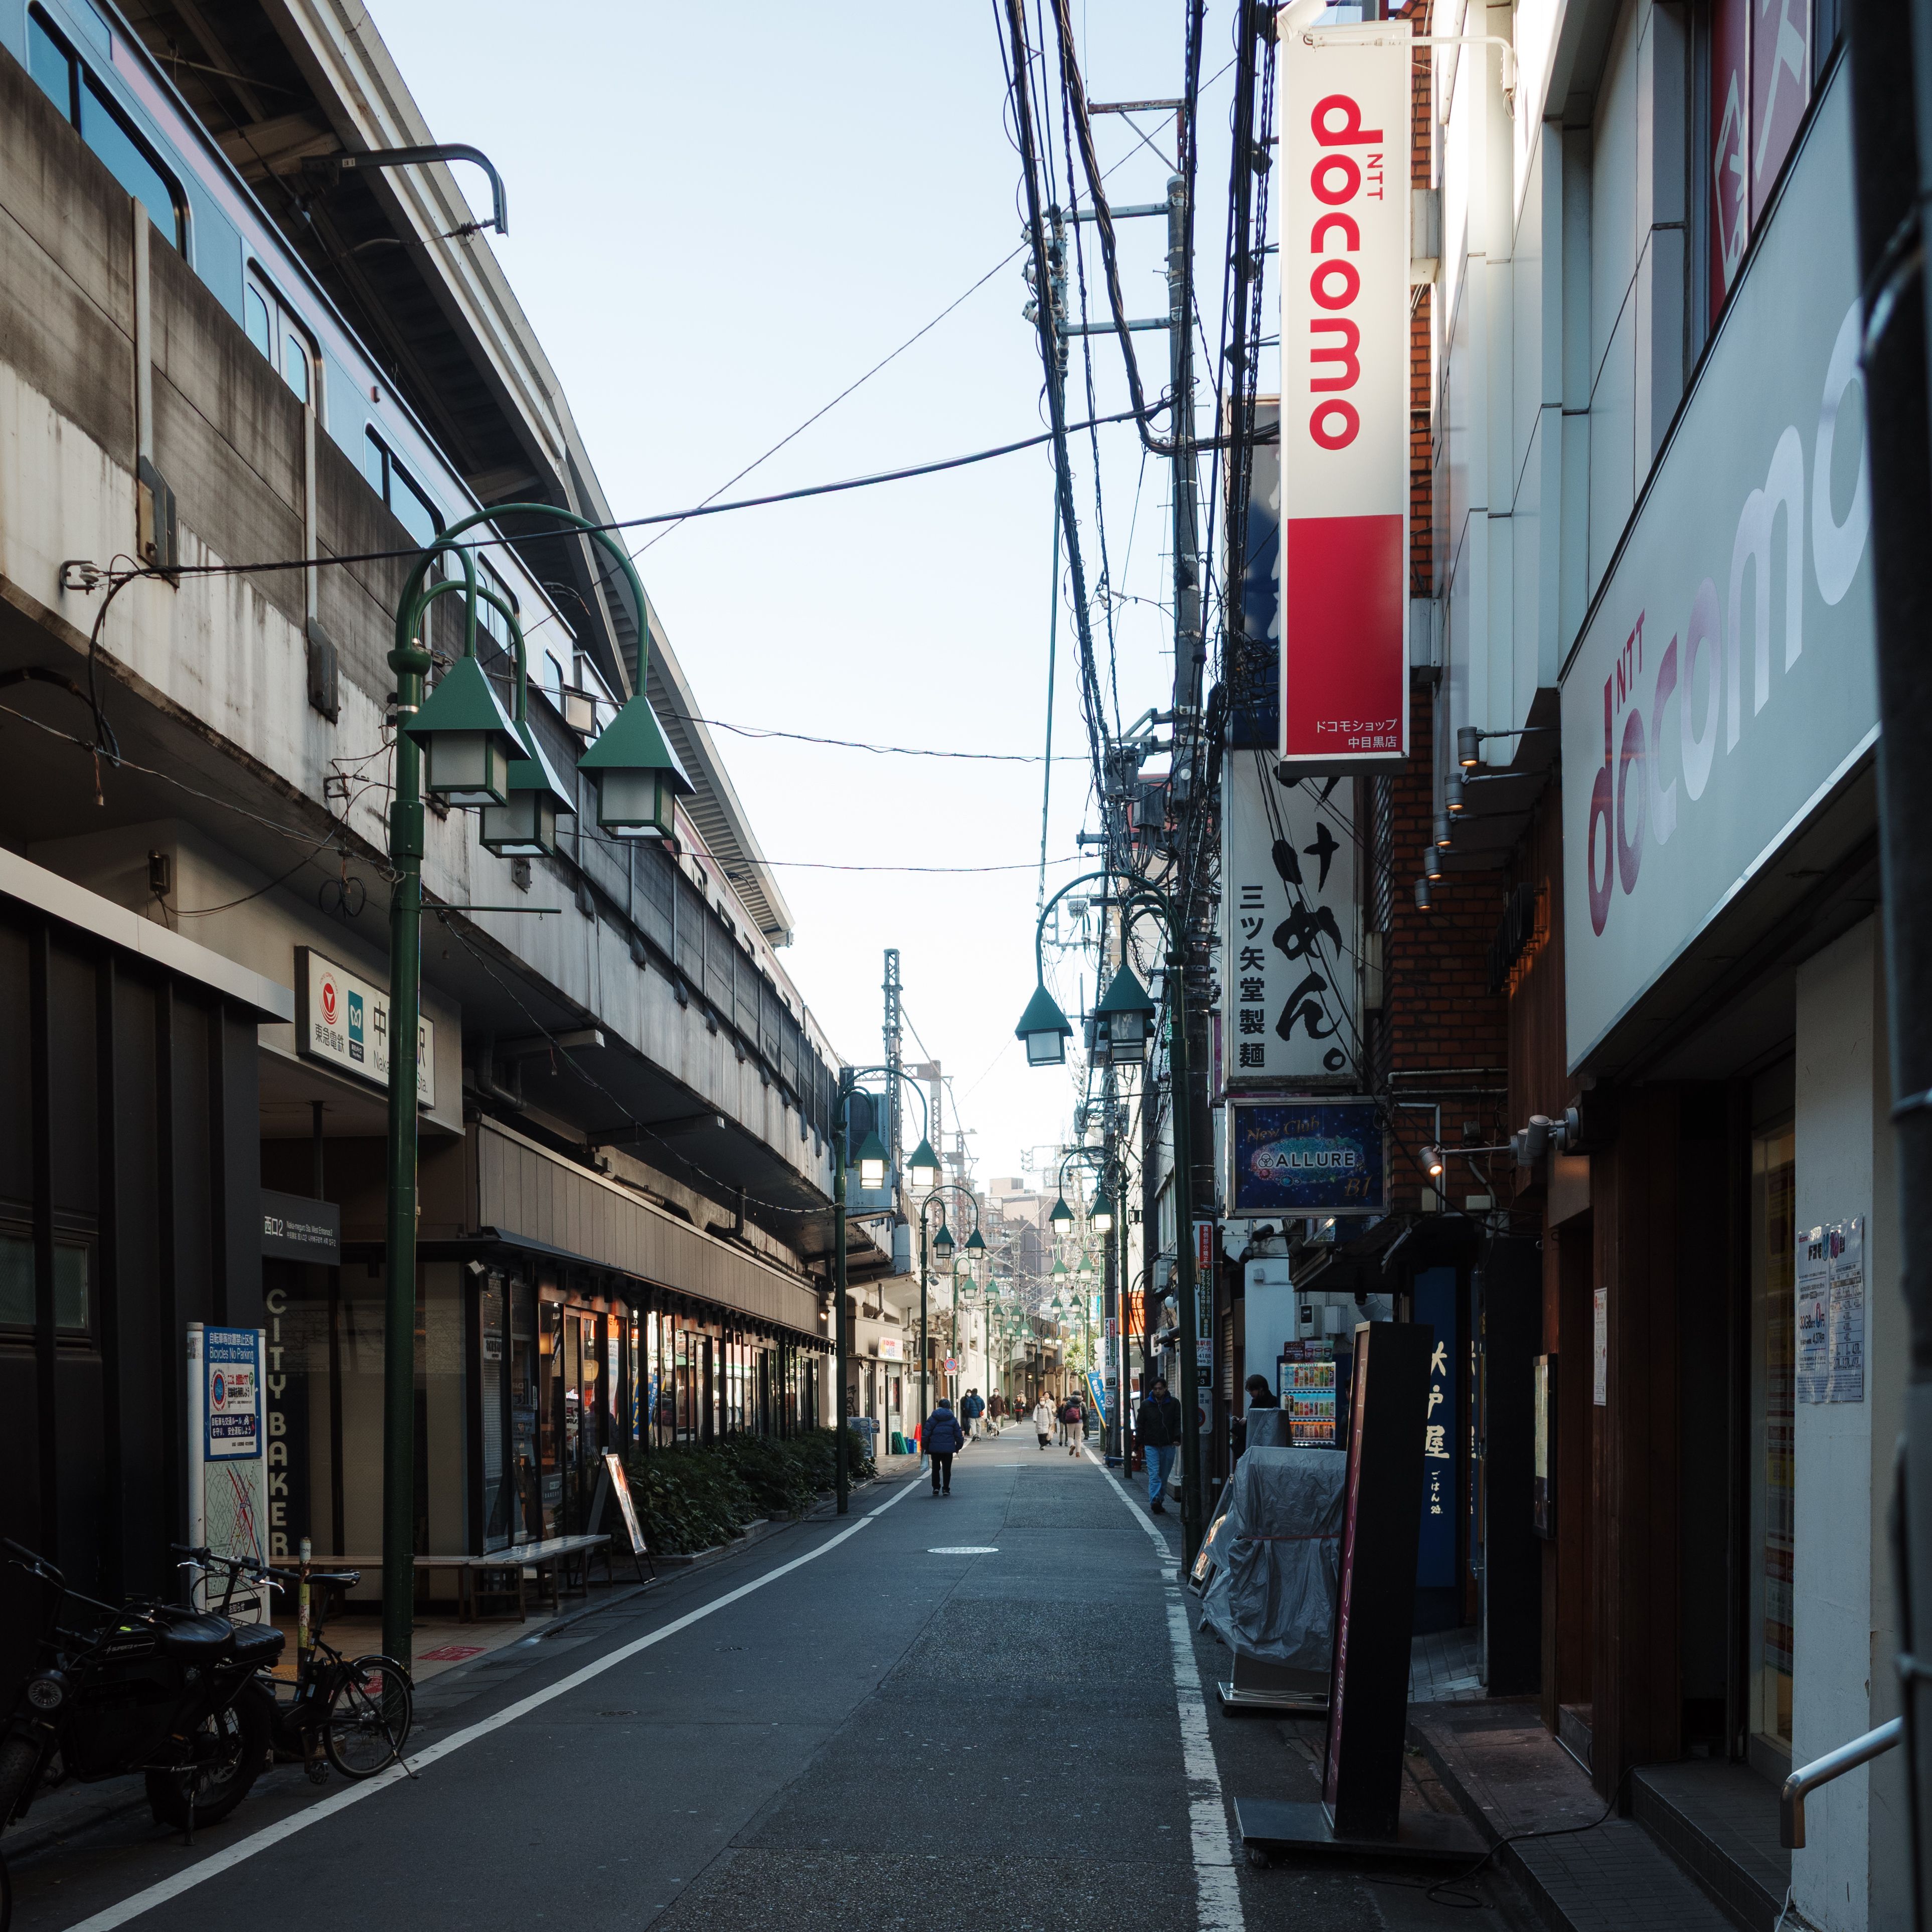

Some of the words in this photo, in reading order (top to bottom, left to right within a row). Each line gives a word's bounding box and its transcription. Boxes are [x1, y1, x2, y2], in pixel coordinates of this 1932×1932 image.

[1367, 153, 1383, 200] NTT
[1310, 94, 1383, 449] docomo
[1617, 608, 1645, 714] NTT
[1317, 719, 1398, 733] ドコモショップ
[1348, 735, 1397, 749] 中目黒店
[1239, 885, 1265, 1068] 三ツ矢堂製麺
[314, 1023, 345, 1054] 東急電鉄
[1247, 1126, 1280, 1143] New
[1283, 1115, 1320, 1134] Club
[1275, 1153, 1355, 1167] ALLURE
[1344, 1176, 1372, 1197] B1
[264, 1216, 283, 1237] 西口2
[209, 1332, 254, 1346] 自転車等放置禁止区域
[266, 1289, 287, 1399] CITY
[210, 1347, 229, 1362] Bicycles
[229, 1347, 236, 1360] No
[237, 1348, 254, 1363] Parking
[1424, 1340, 1450, 1459] 大戸屋
[1430, 1471, 1442, 1514] ごはん処
